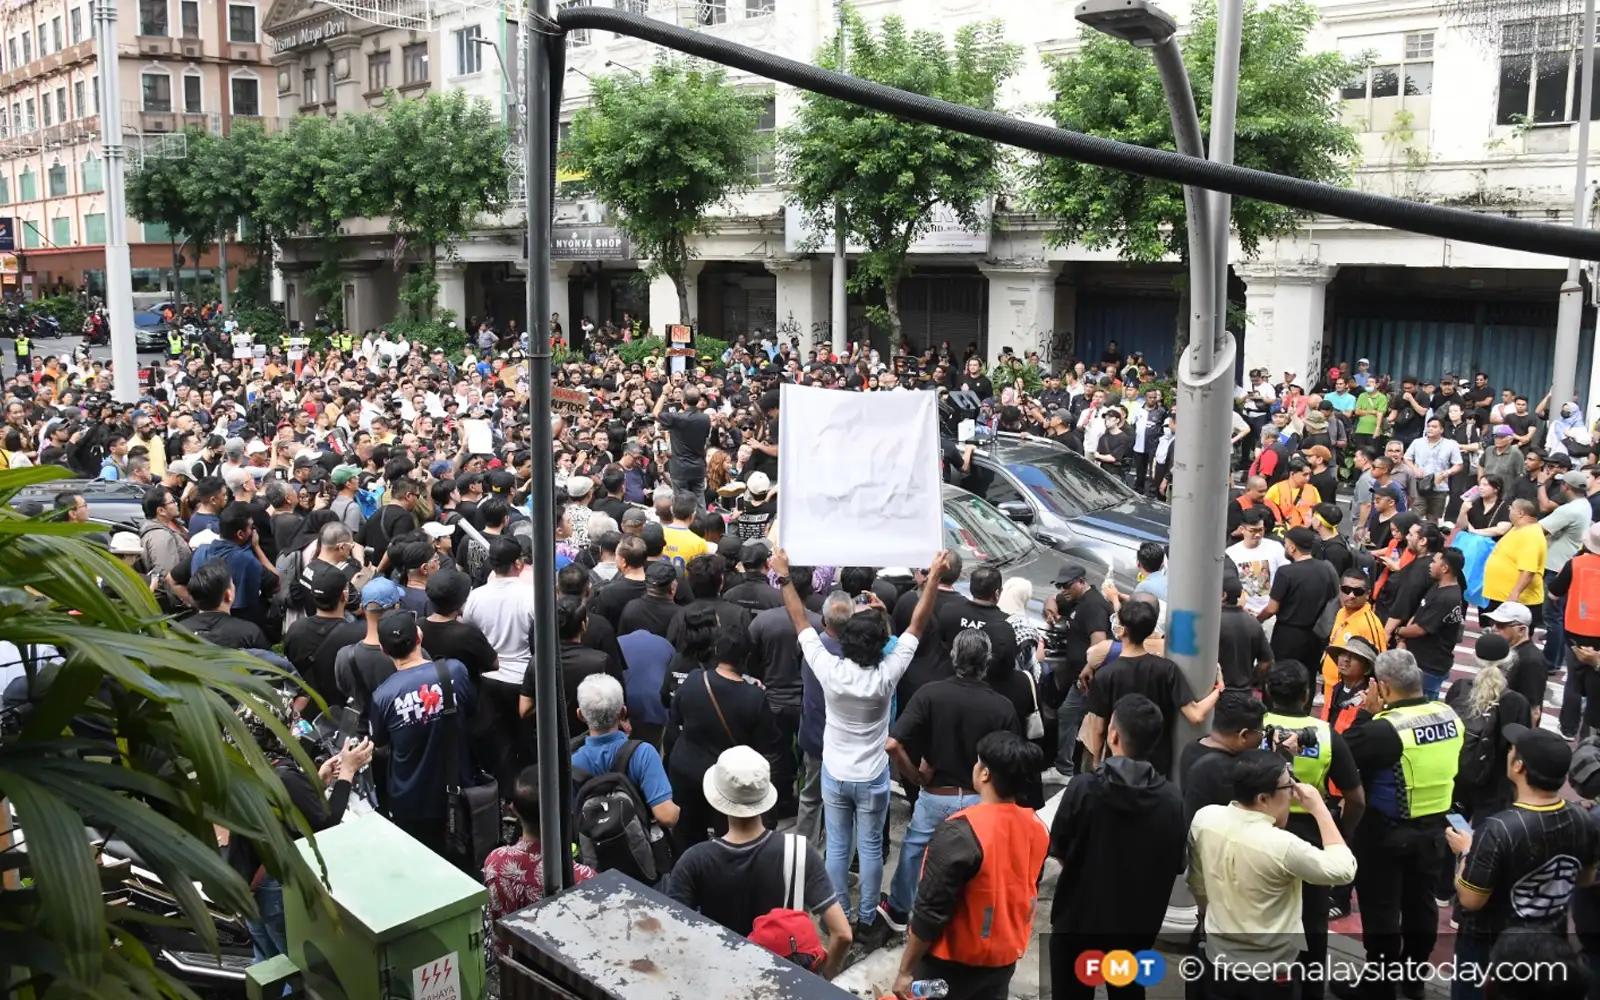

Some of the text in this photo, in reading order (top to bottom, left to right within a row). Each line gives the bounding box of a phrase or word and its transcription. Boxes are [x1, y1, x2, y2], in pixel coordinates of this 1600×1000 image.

[299, 27, 323, 46] Maya
[324, 18, 345, 38] Devi
[556, 239, 592, 248] NYONYA
[595, 238, 622, 248] SHOP
[1414, 722, 1457, 745] POLIS
[421, 985, 455, 1000] AHAYA
